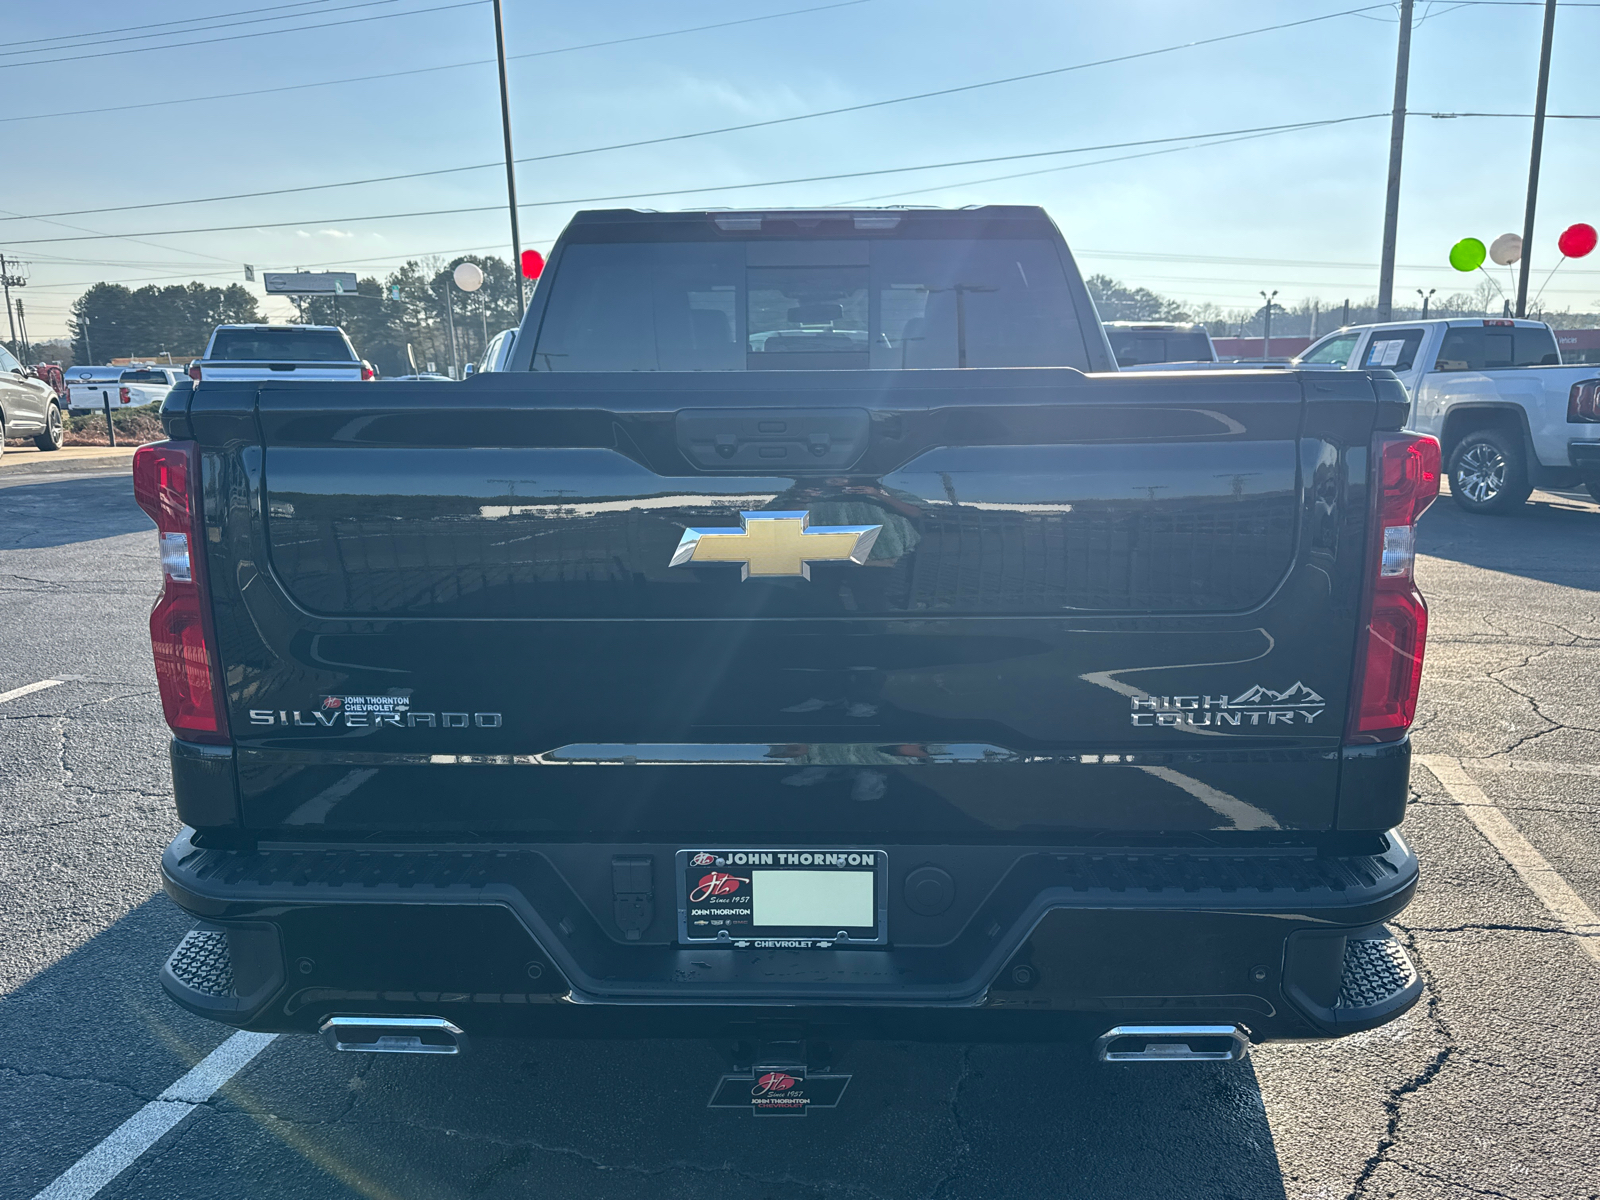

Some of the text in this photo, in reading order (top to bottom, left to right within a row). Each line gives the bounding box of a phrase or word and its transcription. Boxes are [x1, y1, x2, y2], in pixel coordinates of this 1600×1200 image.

[344, 696, 410, 705] JOHN THORNTON
[1130, 695, 1229, 710] HIGH
[344, 704, 394, 712] CHEVROLET
[249, 709, 503, 729] SILVERADO
[1131, 709, 1324, 726] COUNTRY
[725, 853, 875, 866] JOHN THORNTON
[709, 896, 751, 904] Since 1957
[691, 908, 751, 916] JOHN THORNTON
[754, 940, 813, 948] CHEVROLET
